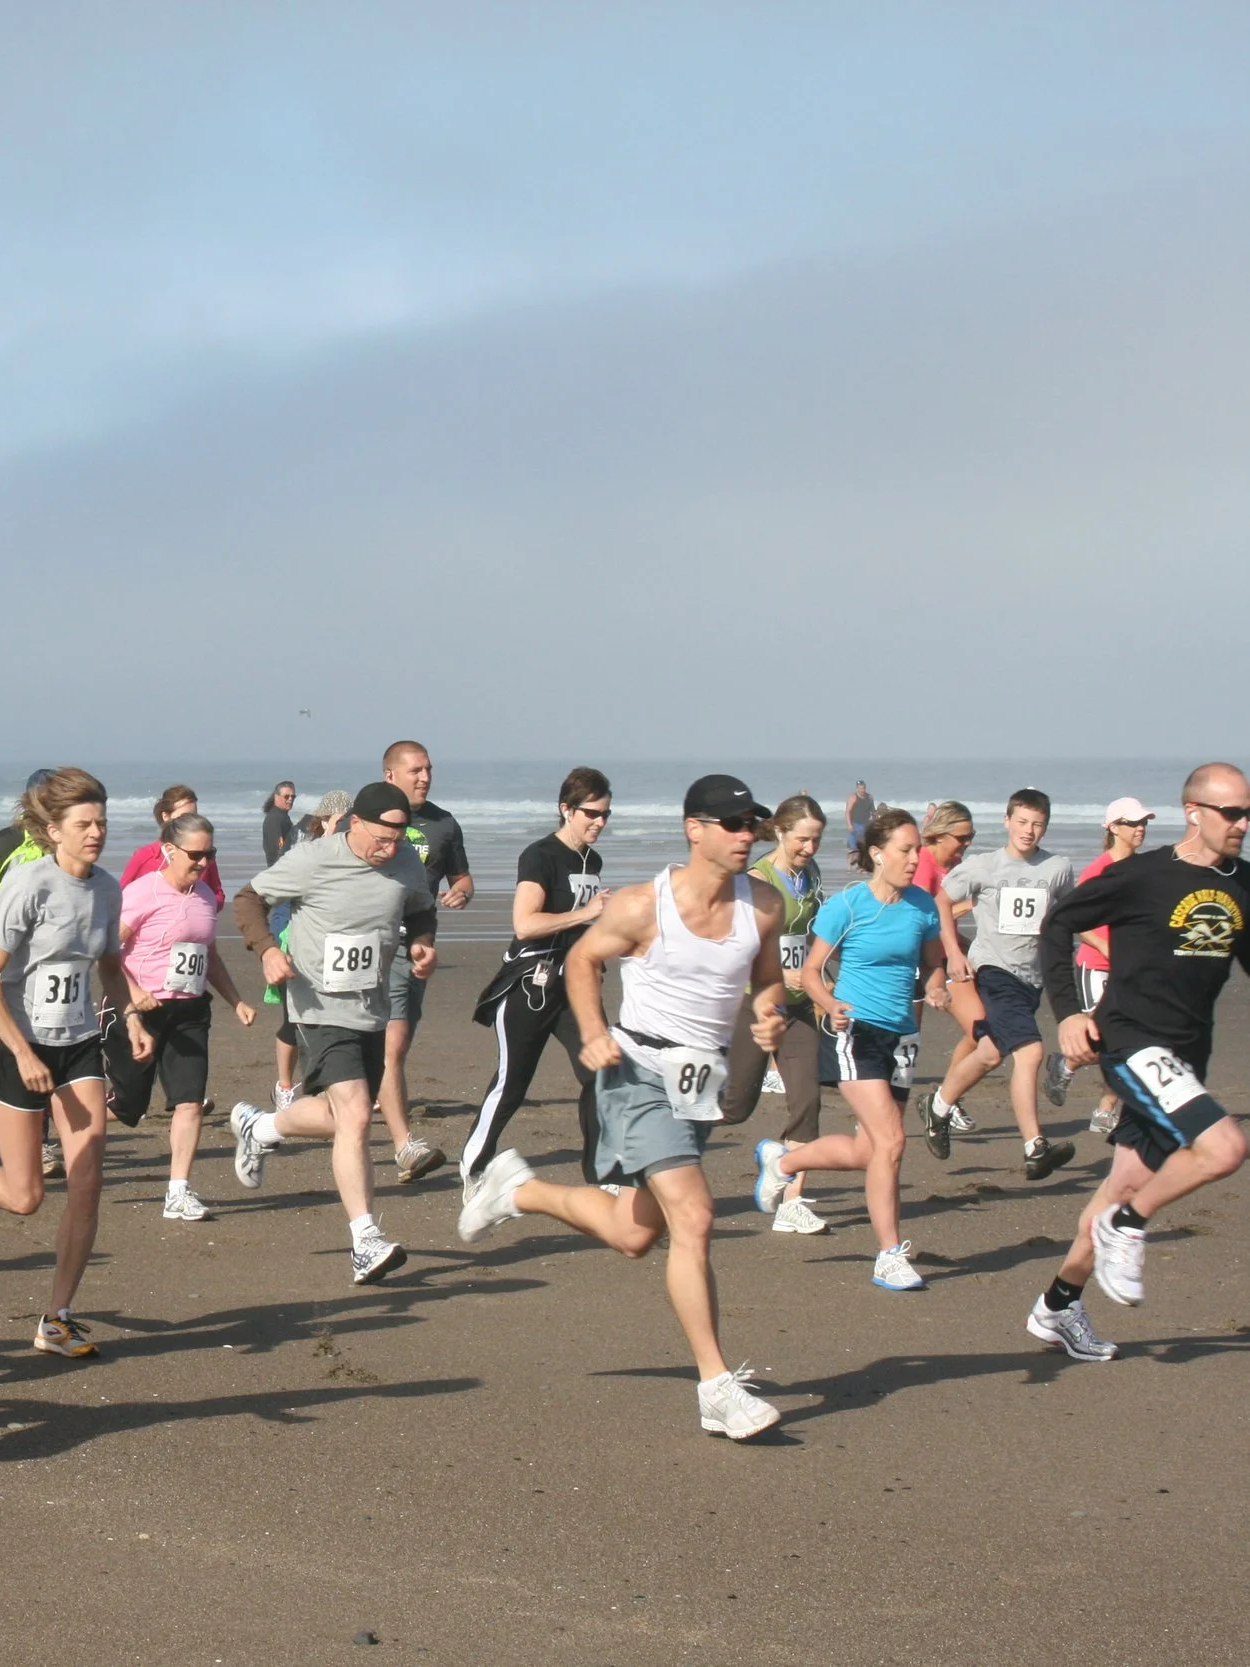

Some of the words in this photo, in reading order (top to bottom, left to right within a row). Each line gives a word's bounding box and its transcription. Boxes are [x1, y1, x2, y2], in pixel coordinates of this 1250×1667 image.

[1013, 897, 1035, 918] 85
[175, 952, 204, 976] 290
[332, 945, 373, 972] 289
[782, 945, 805, 969] 267
[45, 972, 81, 1004] 315
[678, 1063, 711, 1094] 80
